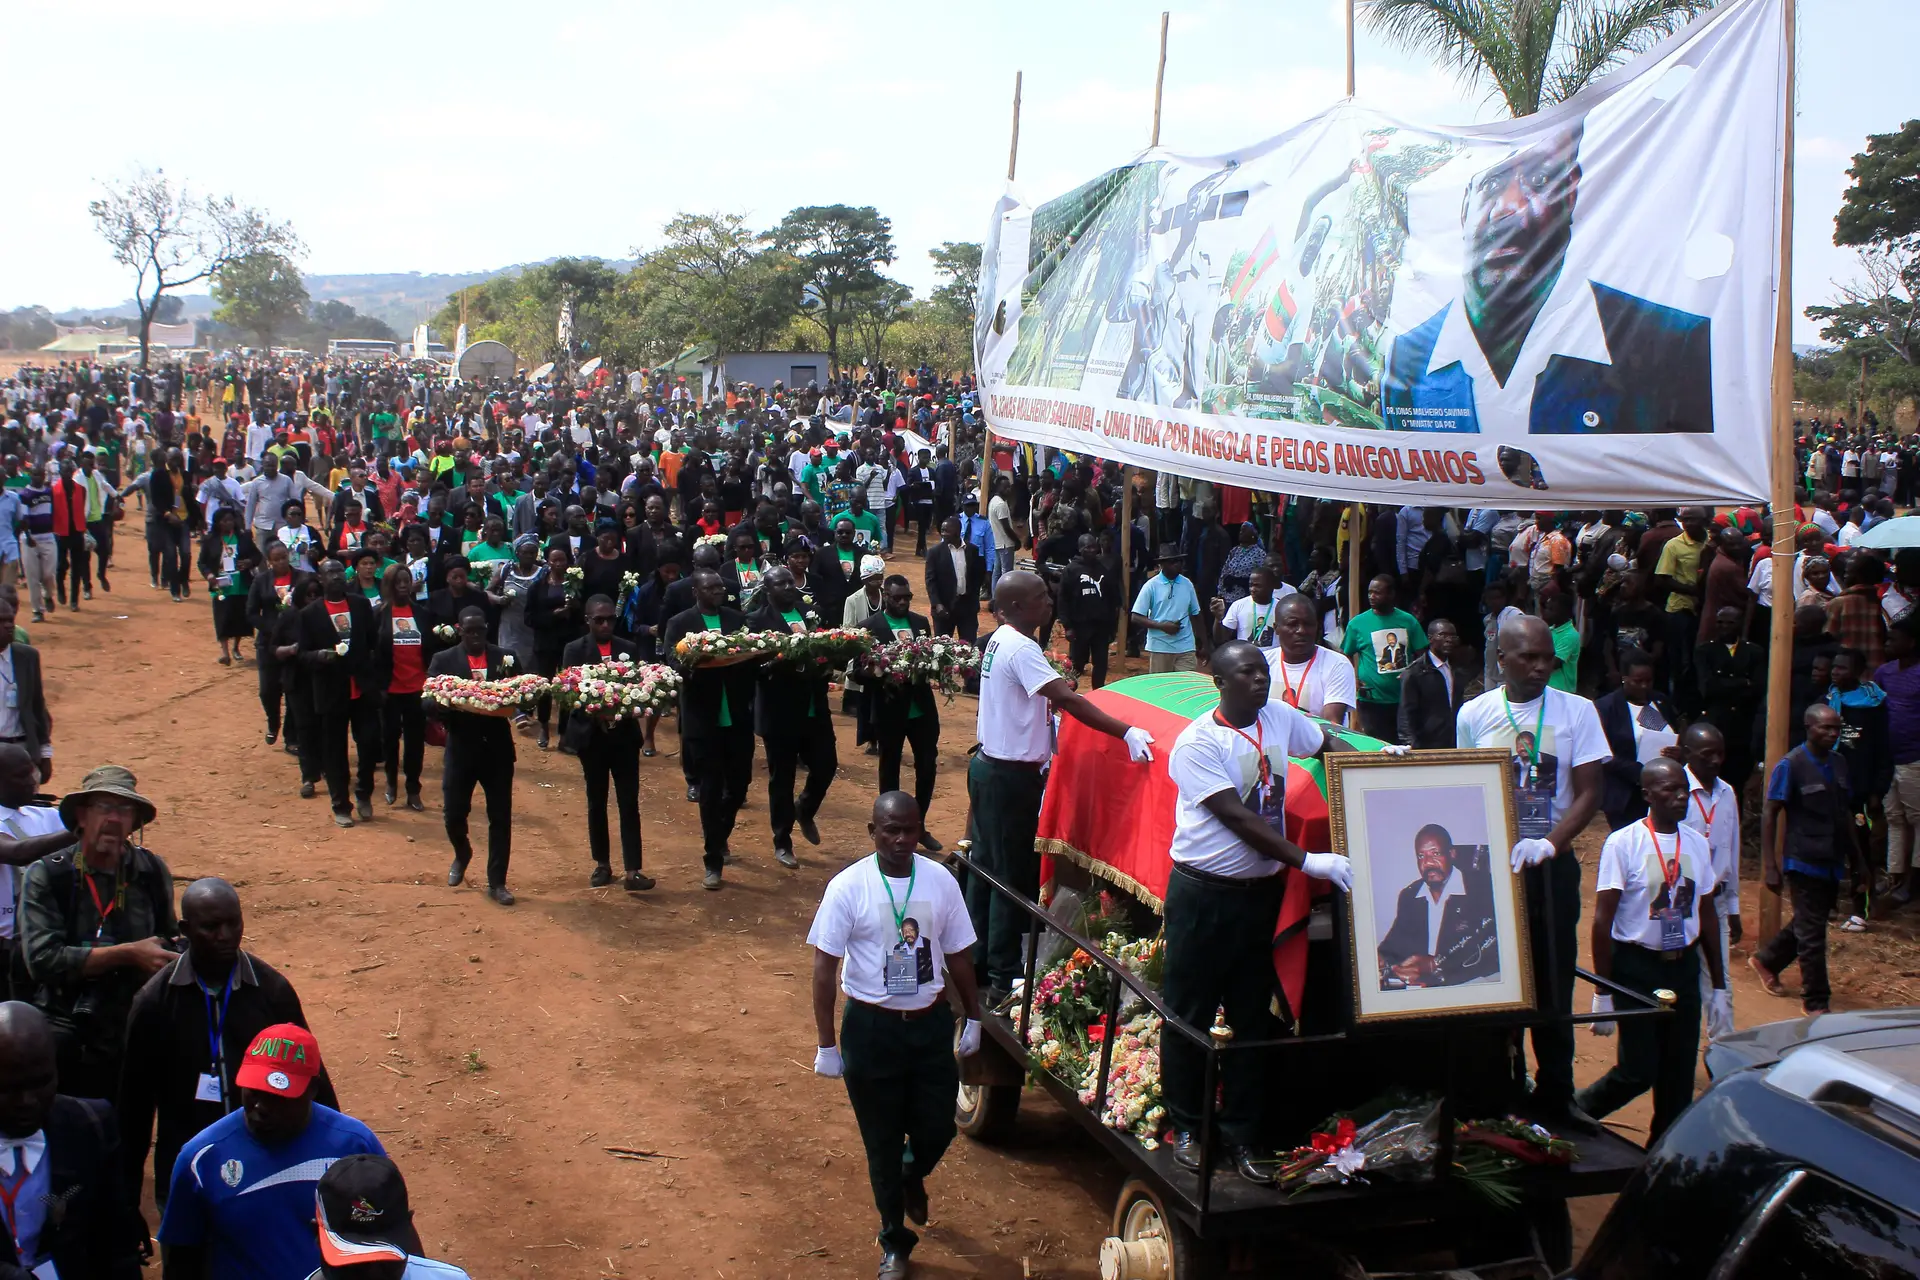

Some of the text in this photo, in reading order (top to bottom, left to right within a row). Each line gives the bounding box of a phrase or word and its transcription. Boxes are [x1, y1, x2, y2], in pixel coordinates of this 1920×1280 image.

[1386, 406, 1471, 417] DR. JONAS MALHEIRO SAVIMBI
[1435, 420, 1443, 428] DA
[1016, 397, 1052, 423] MALHEIRO
[1049, 400, 1095, 432] SAVIMBI
[1103, 410, 1131, 441] UMA
[1133, 415, 1163, 447] VIDA
[1162, 421, 1190, 453] POR
[1192, 426, 1253, 464] ANGOLA
[1256, 434, 1267, 467] E
[1271, 436, 1330, 475] PELOS
[1335, 443, 1486, 485] ANGOLANOS
[251, 1037, 306, 1065] UNITA
